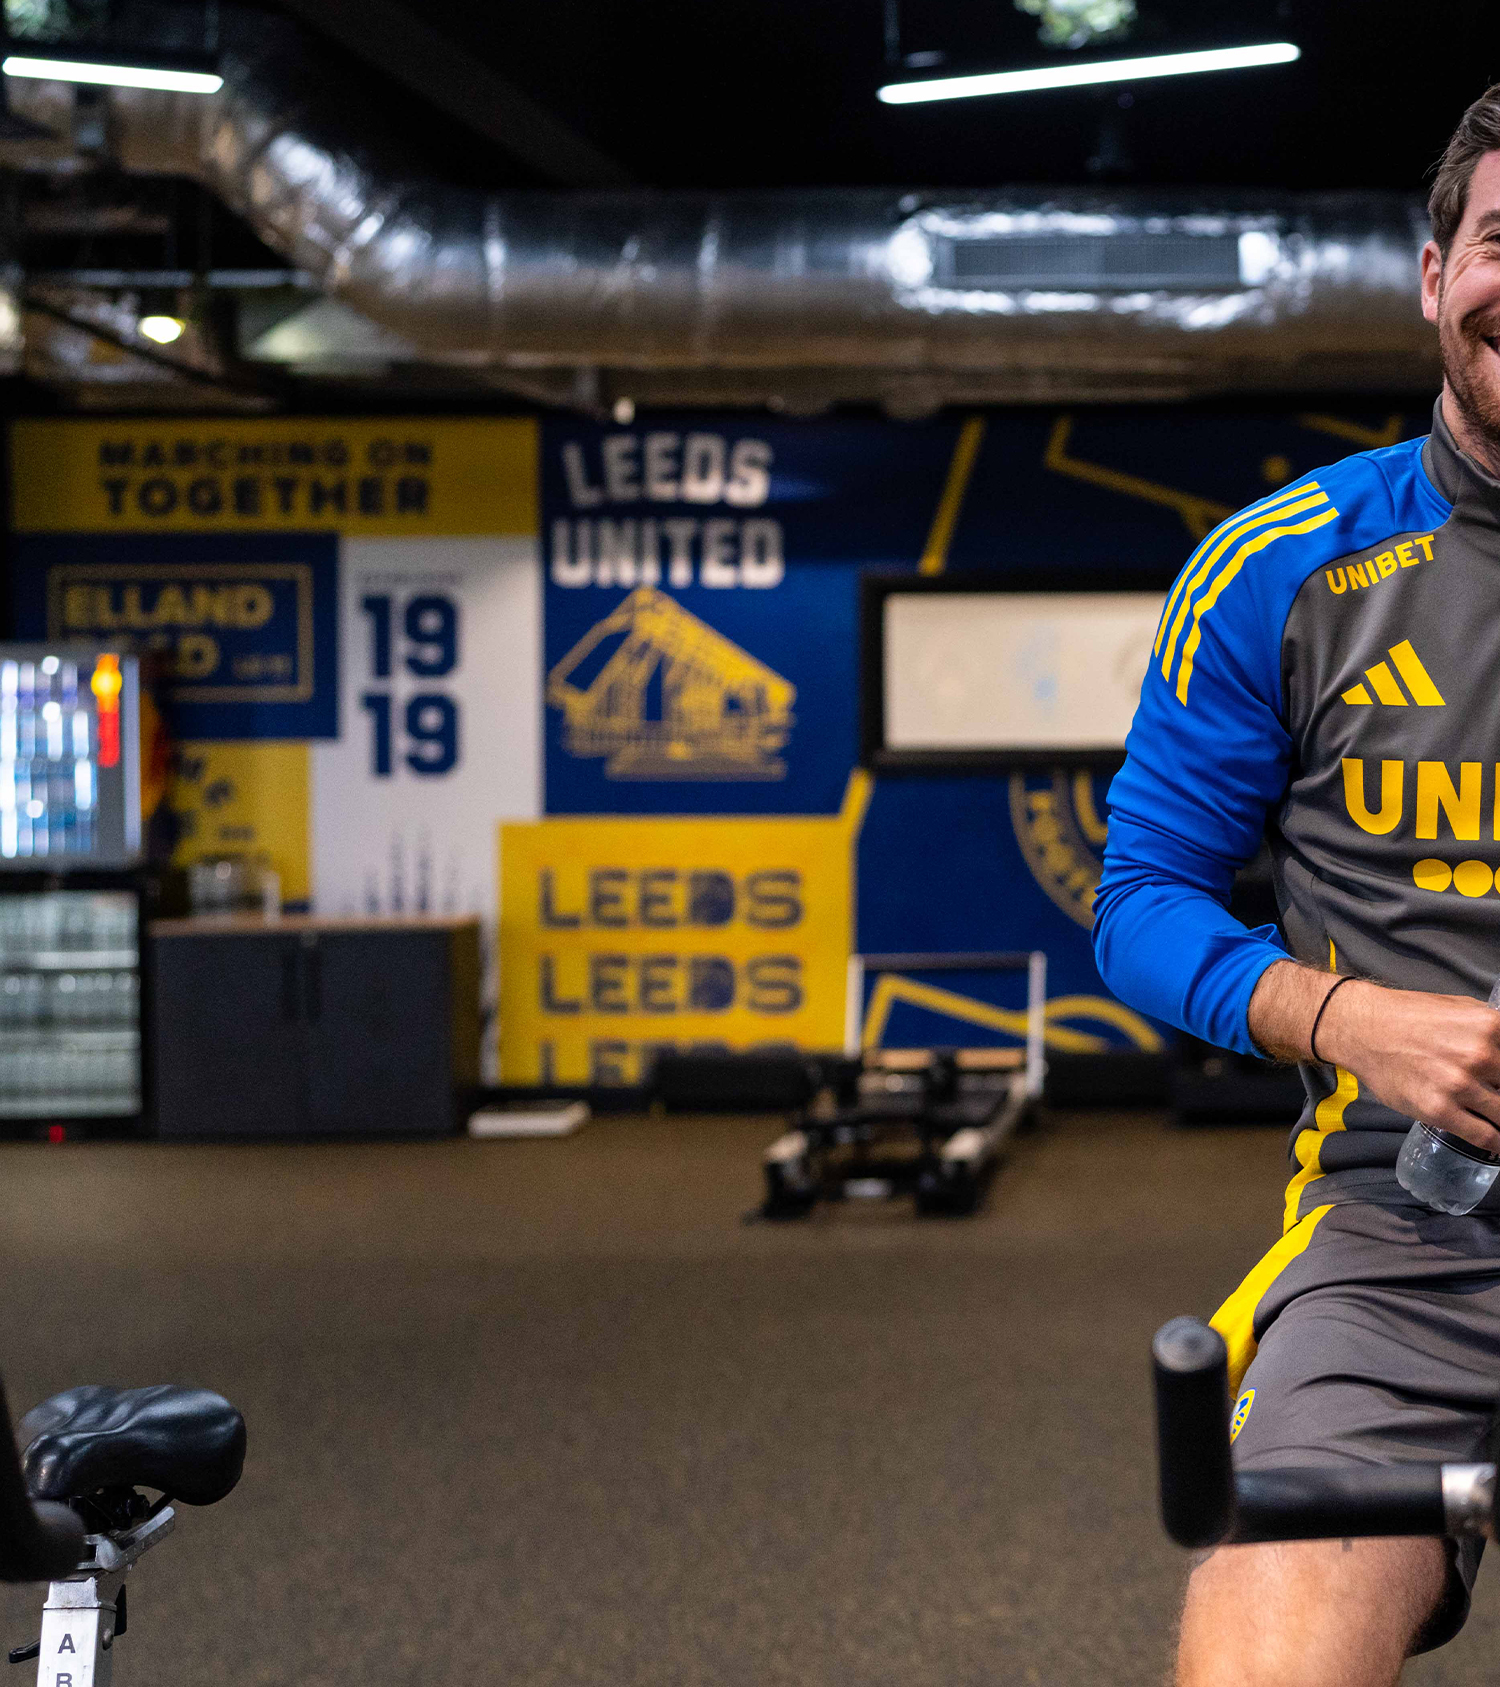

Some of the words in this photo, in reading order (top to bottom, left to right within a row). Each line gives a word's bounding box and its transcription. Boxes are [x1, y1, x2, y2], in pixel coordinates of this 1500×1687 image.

[99, 438, 349, 468] MARCHING
[367, 438, 434, 468] ON
[563, 432, 773, 508] LEEDS
[101, 476, 432, 517] TOGETHER
[551, 517, 786, 589] UNITED
[1325, 534, 1435, 595] UNIBET
[65, 584, 274, 629] ELLAND
[360, 594, 459, 678] 19
[360, 692, 459, 779] 19
[539, 868, 805, 929] LEEDS
[539, 955, 805, 1015] LEEDS
[57, 1633, 76, 1654] A
